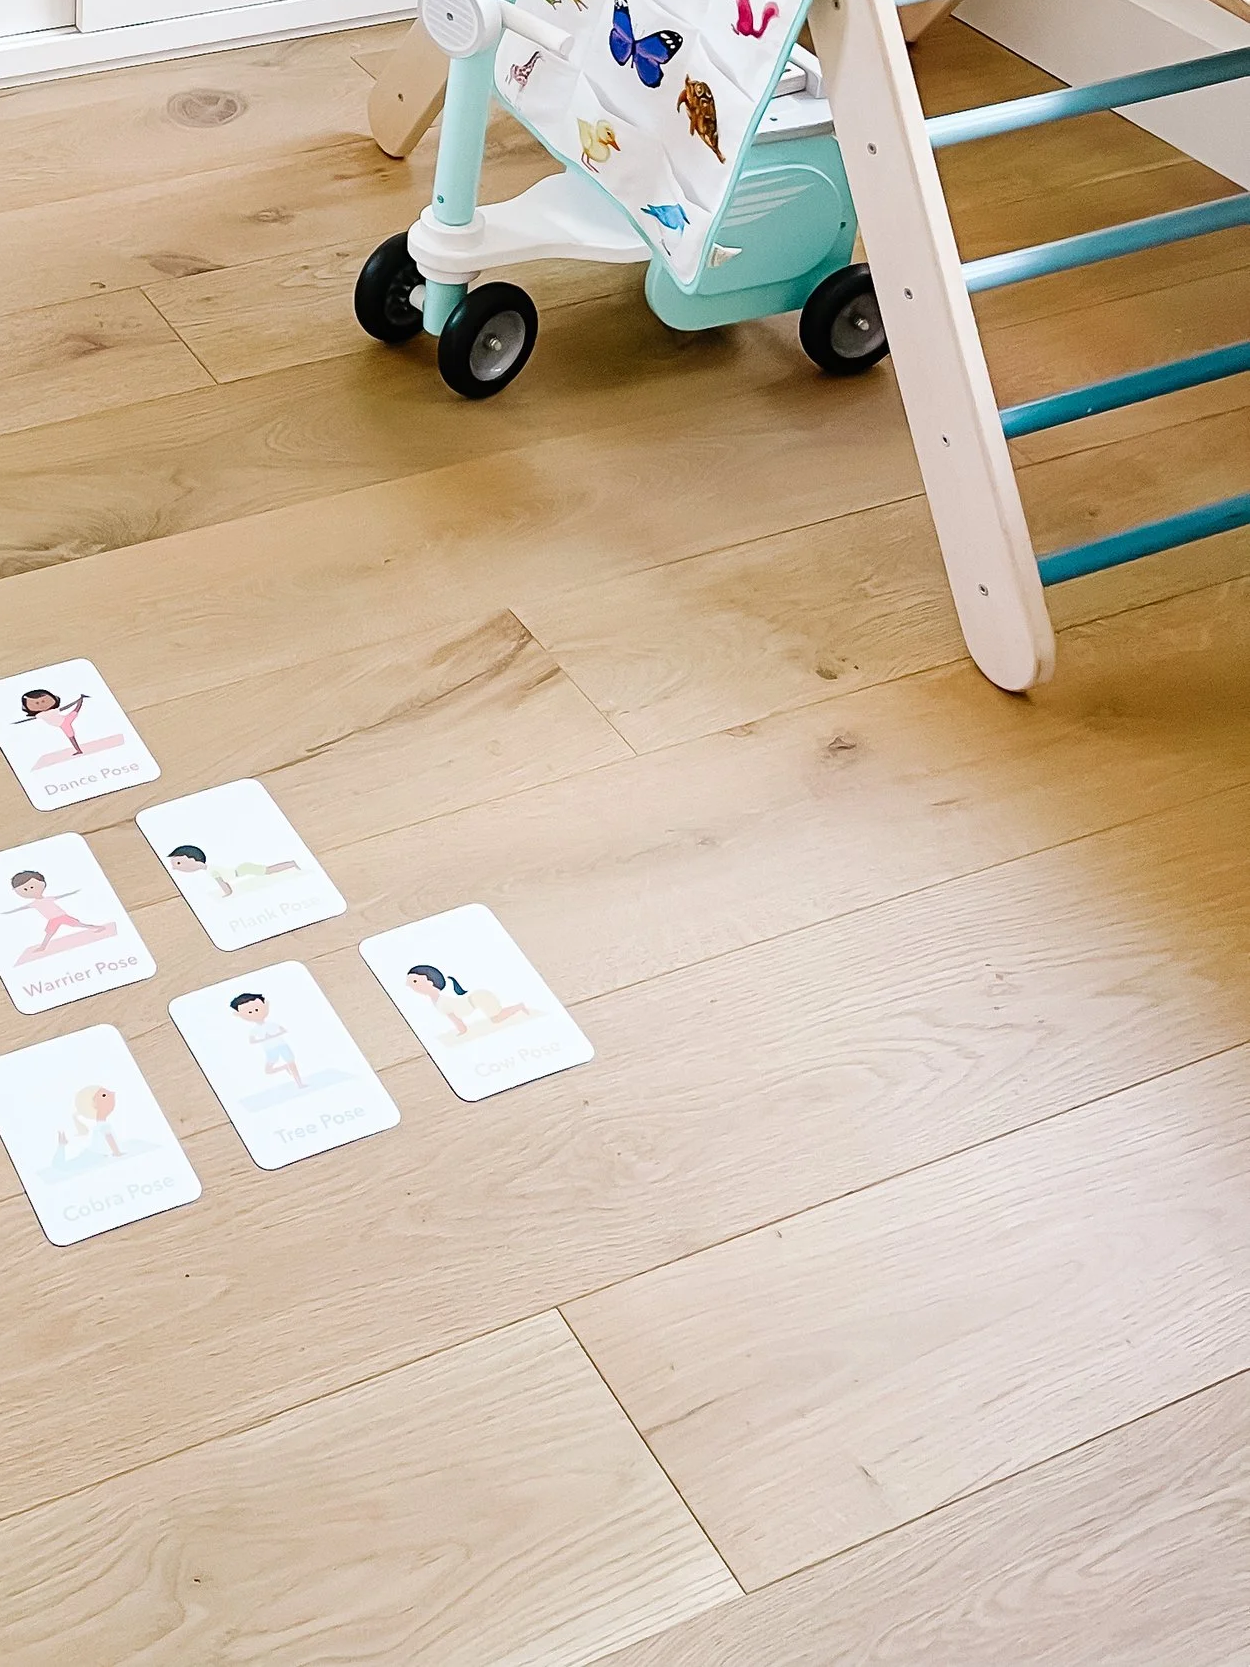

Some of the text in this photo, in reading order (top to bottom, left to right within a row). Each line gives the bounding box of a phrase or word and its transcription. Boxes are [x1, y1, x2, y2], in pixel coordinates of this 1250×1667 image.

[44, 762, 140, 796] Dance Pose
[228, 896, 320, 934] Plank Pose
[22, 954, 139, 998] Warrier Pose
[473, 1041, 562, 1078] Cow Pose
[273, 1105, 365, 1145] Tree Pose
[62, 1175, 176, 1222] Cobra Pose
